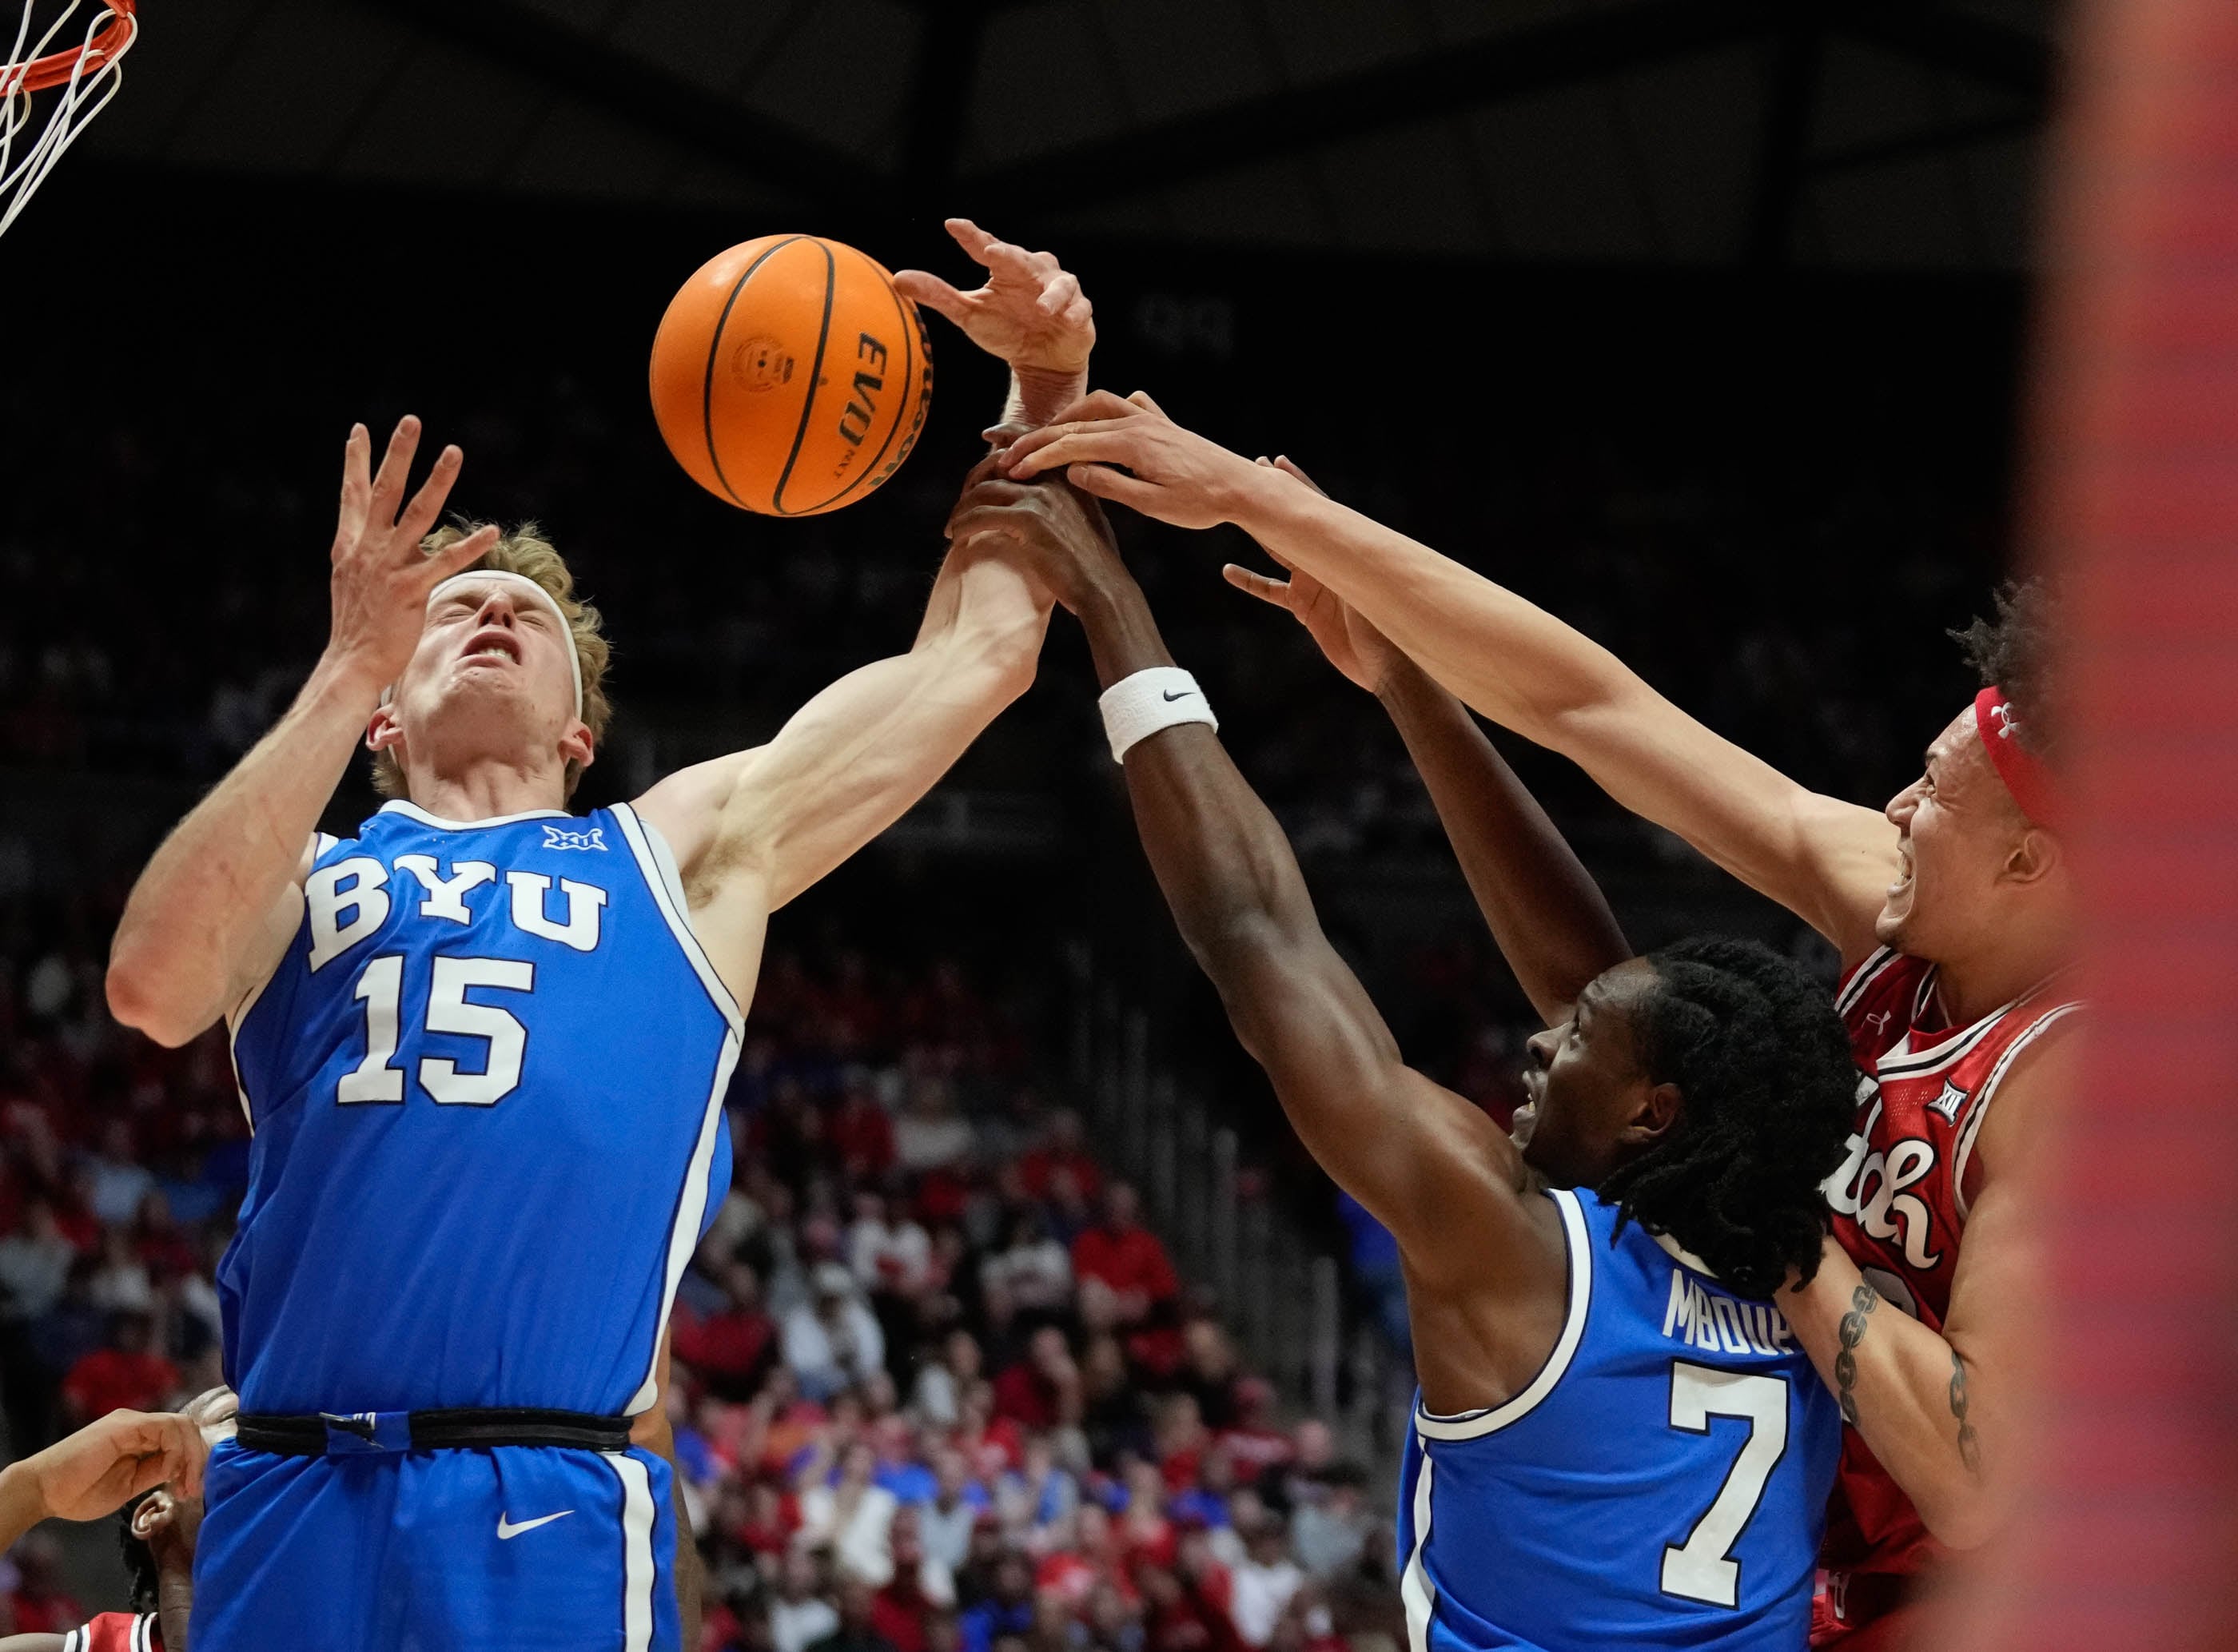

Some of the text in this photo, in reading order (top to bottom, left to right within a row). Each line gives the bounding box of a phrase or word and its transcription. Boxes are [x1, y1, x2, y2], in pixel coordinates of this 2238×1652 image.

[839, 332, 887, 446] EVO
[305, 854, 607, 973] BYU
[337, 955, 535, 1105] 15
[1818, 1075, 1940, 1269] tah
[1660, 1361, 1790, 1609] 7
